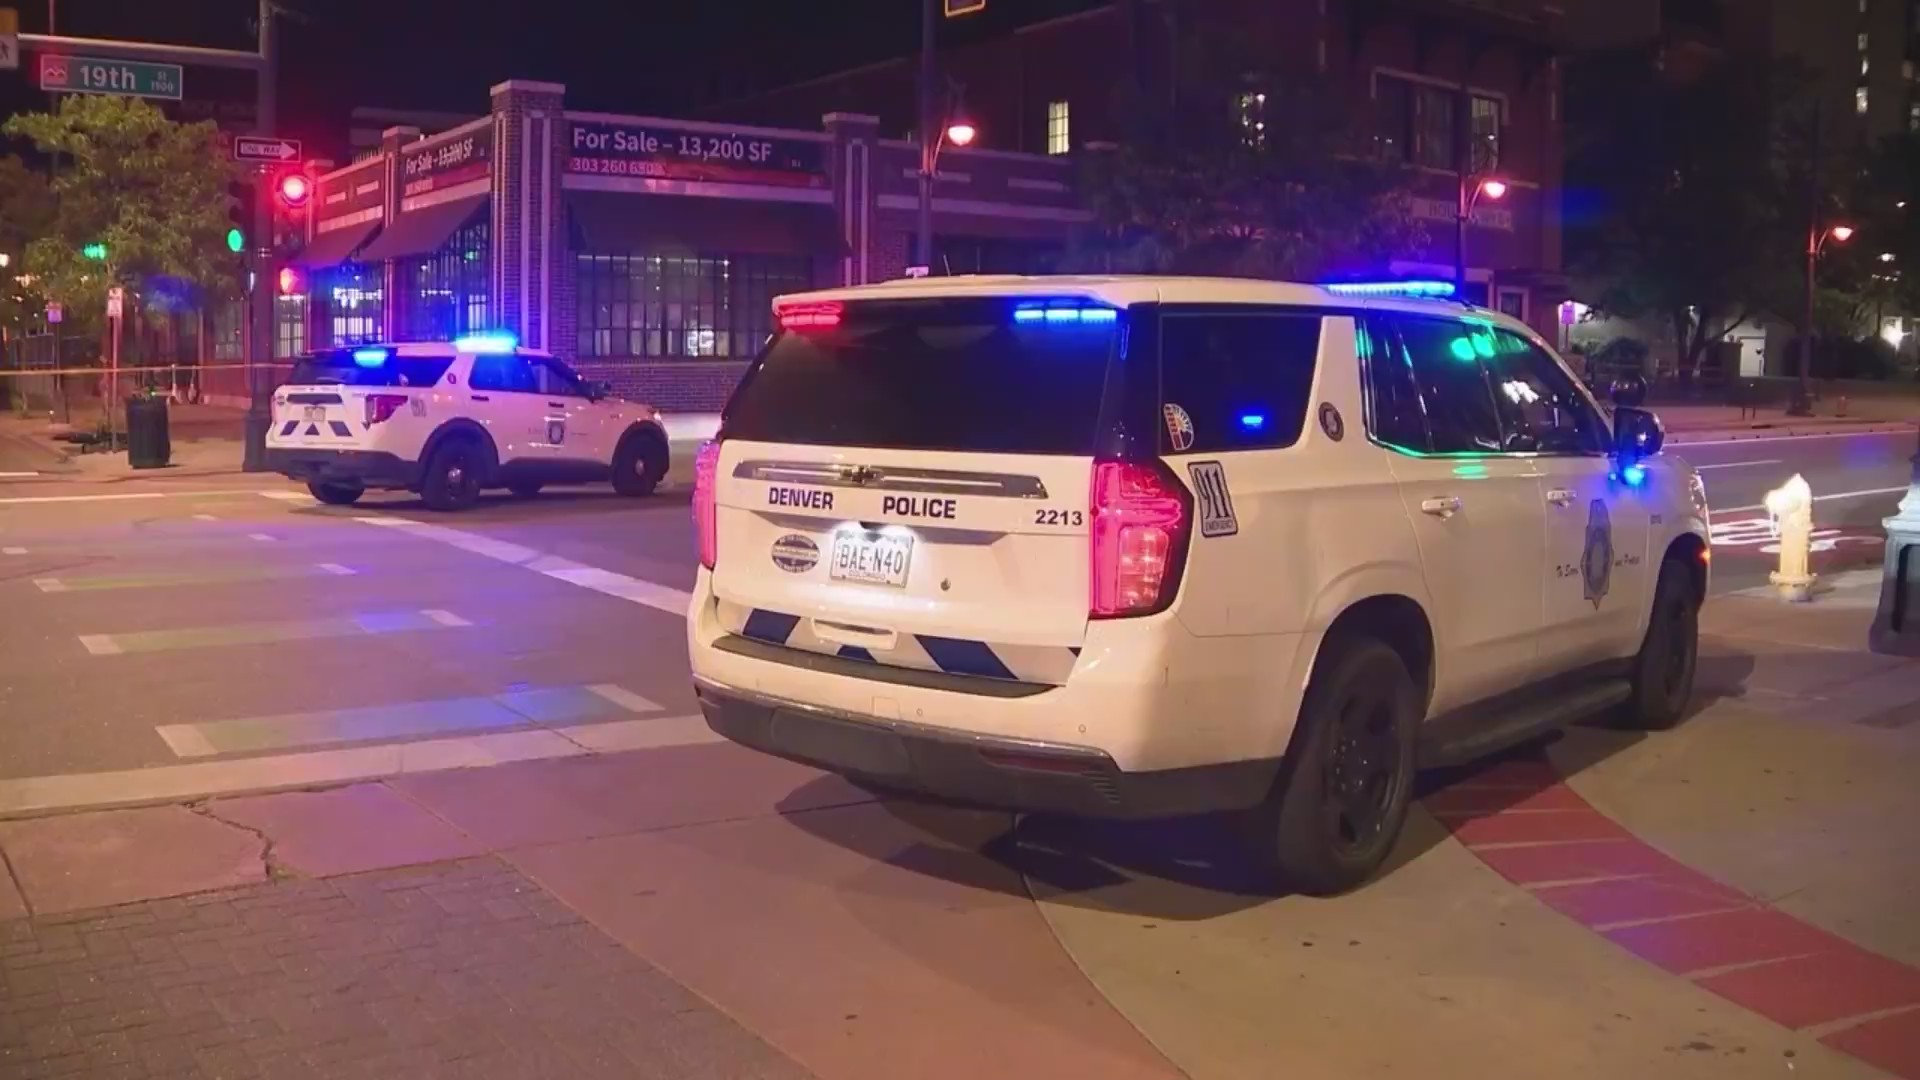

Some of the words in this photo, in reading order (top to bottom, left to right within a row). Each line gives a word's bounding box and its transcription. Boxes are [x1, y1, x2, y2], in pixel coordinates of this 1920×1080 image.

[80, 65, 136, 90] 19th
[573, 127, 608, 149] For
[614, 131, 658, 153] Sale
[679, 136, 744, 162] 13,200
[748, 142, 772, 162] SF
[406, 158, 418, 175] For
[573, 157, 598, 173] 303
[601, 159, 626, 174] 260
[768, 486, 834, 511] DENVER
[1194, 467, 1231, 519] 911
[882, 495, 957, 519] POLICE
[1034, 508, 1084, 527] 2213
